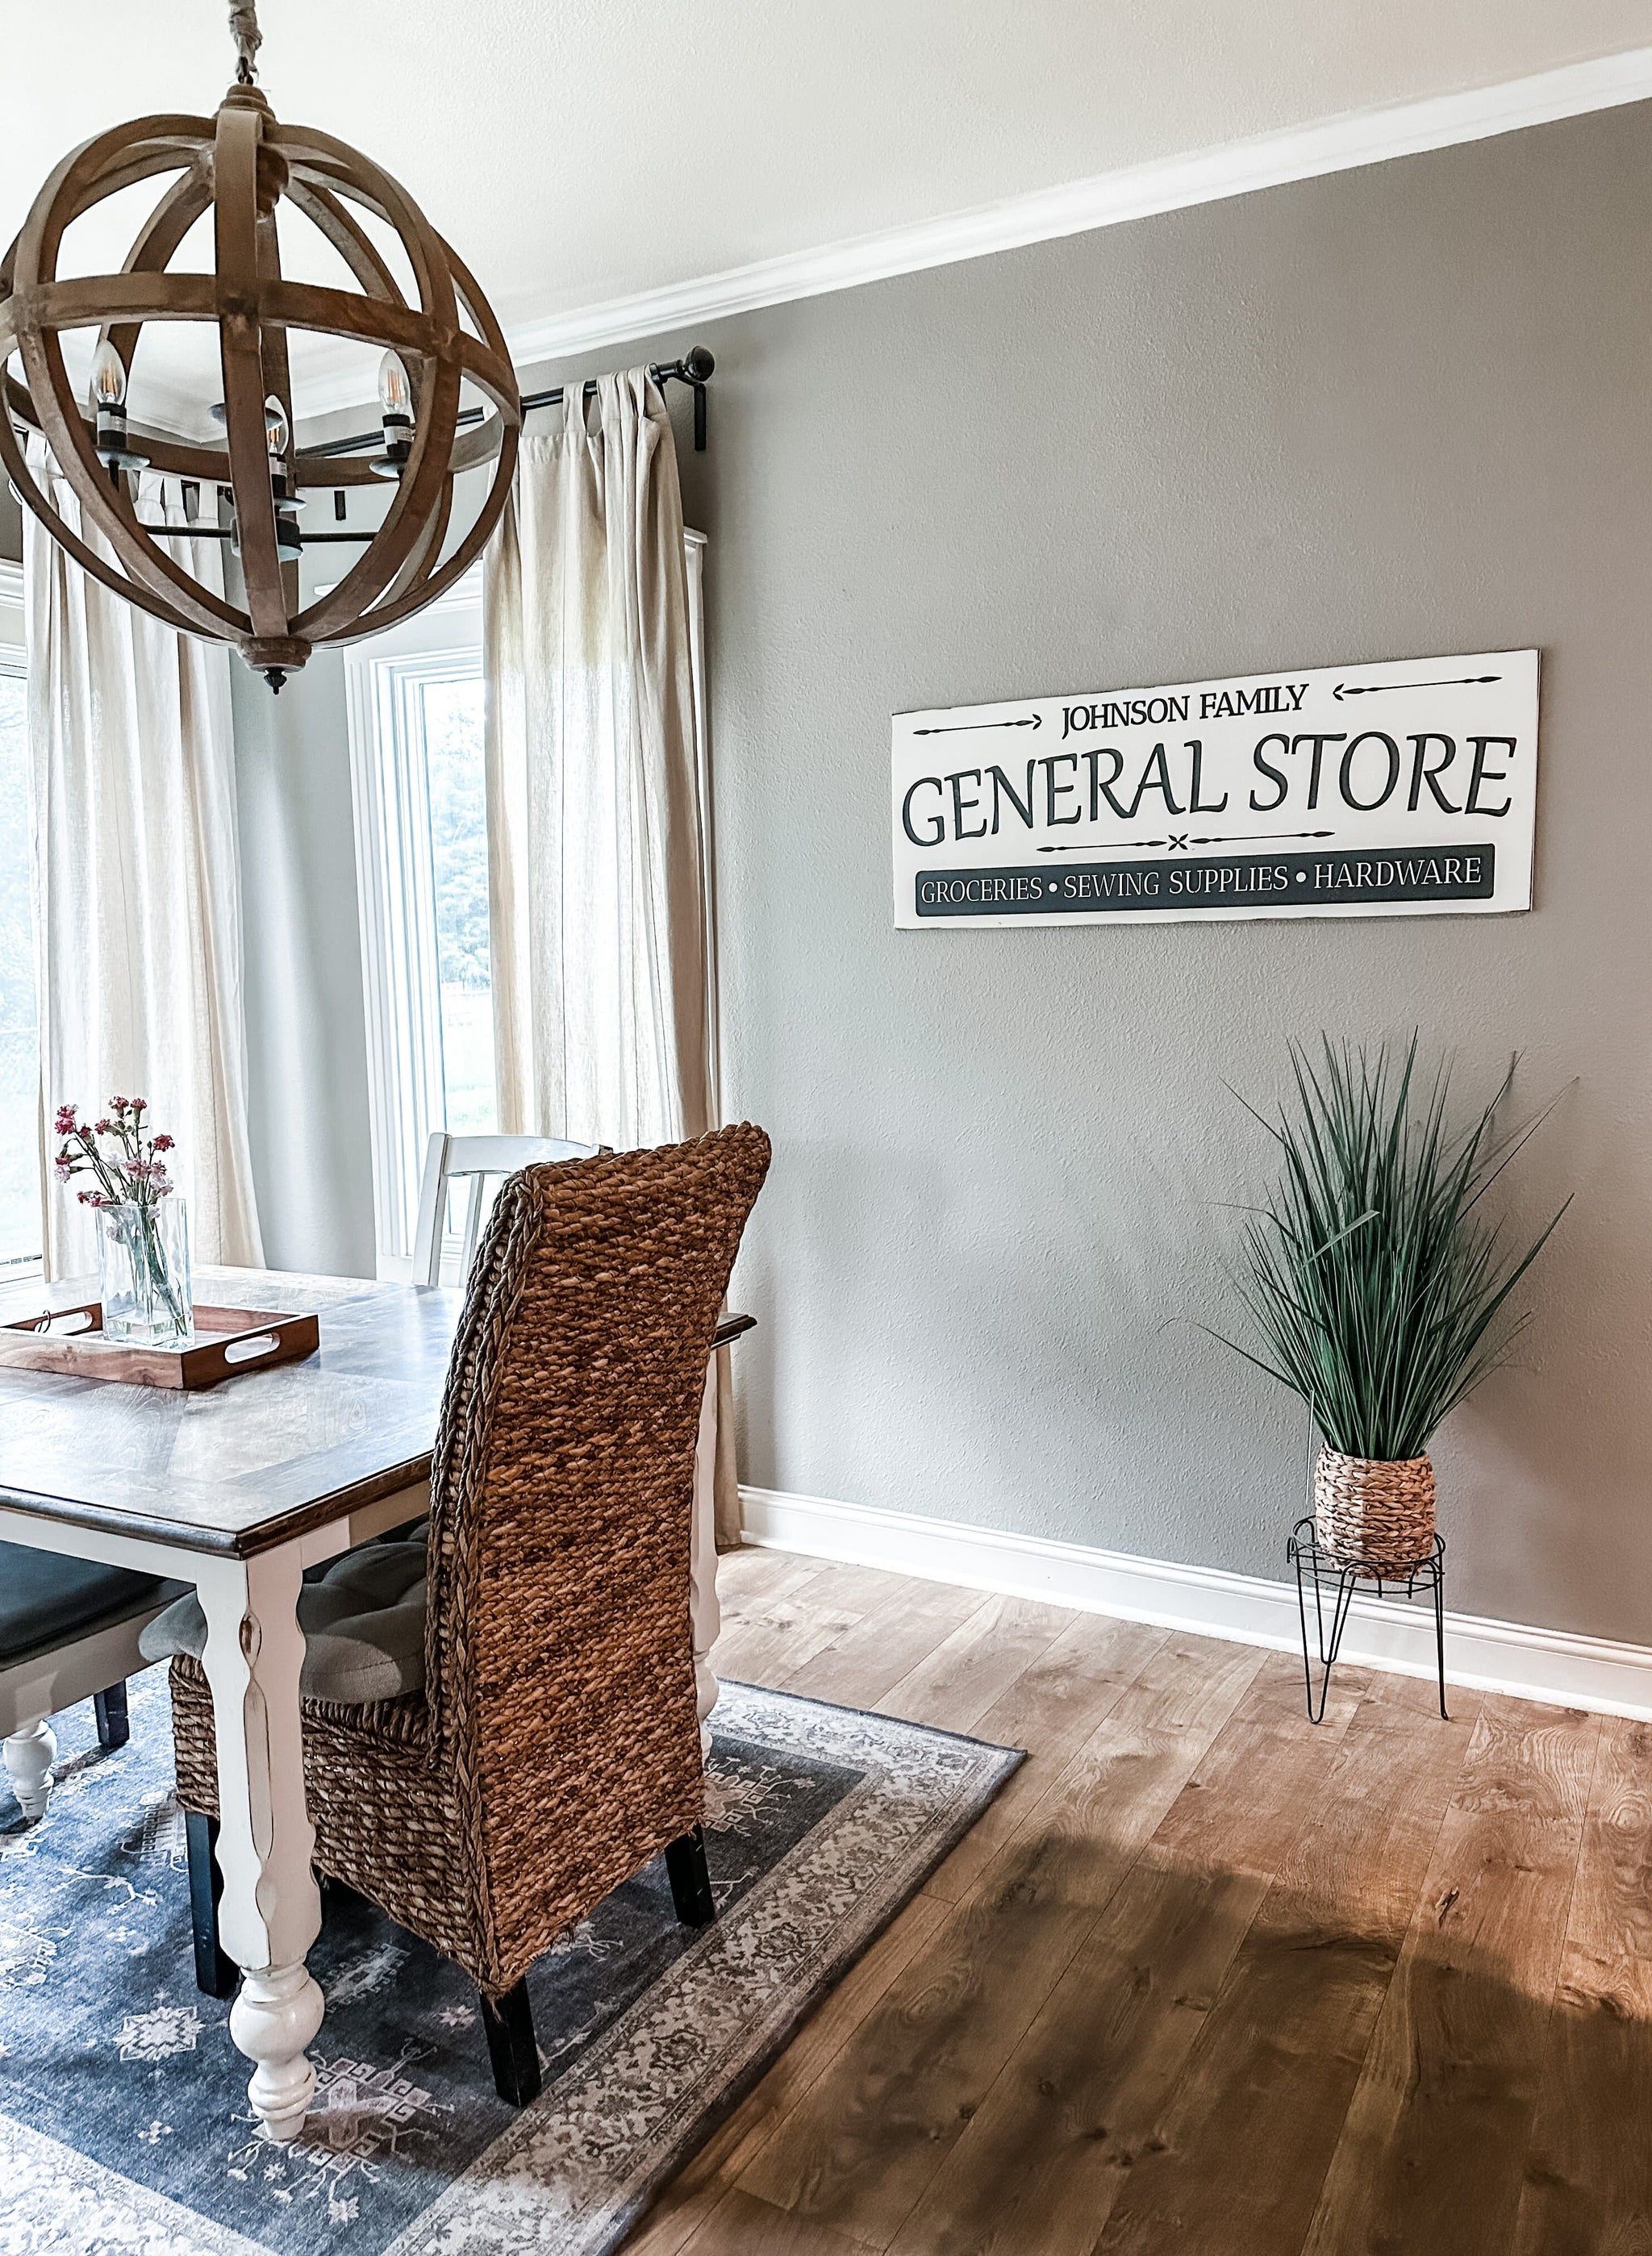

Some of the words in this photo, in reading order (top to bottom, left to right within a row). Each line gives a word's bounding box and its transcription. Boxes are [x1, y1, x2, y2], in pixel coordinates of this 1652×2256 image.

[1062, 694, 1191, 740] JOHNSON
[1199, 683, 1310, 719] FAMILY
[902, 740, 1229, 847] GENERAL
[1249, 731, 1517, 818] STORE
[921, 877, 1043, 904] GROCERIES
[1064, 872, 1161, 899] SEWING
[1169, 865, 1289, 894] SUPPLIES
[1313, 857, 1483, 890] HARDWARE
